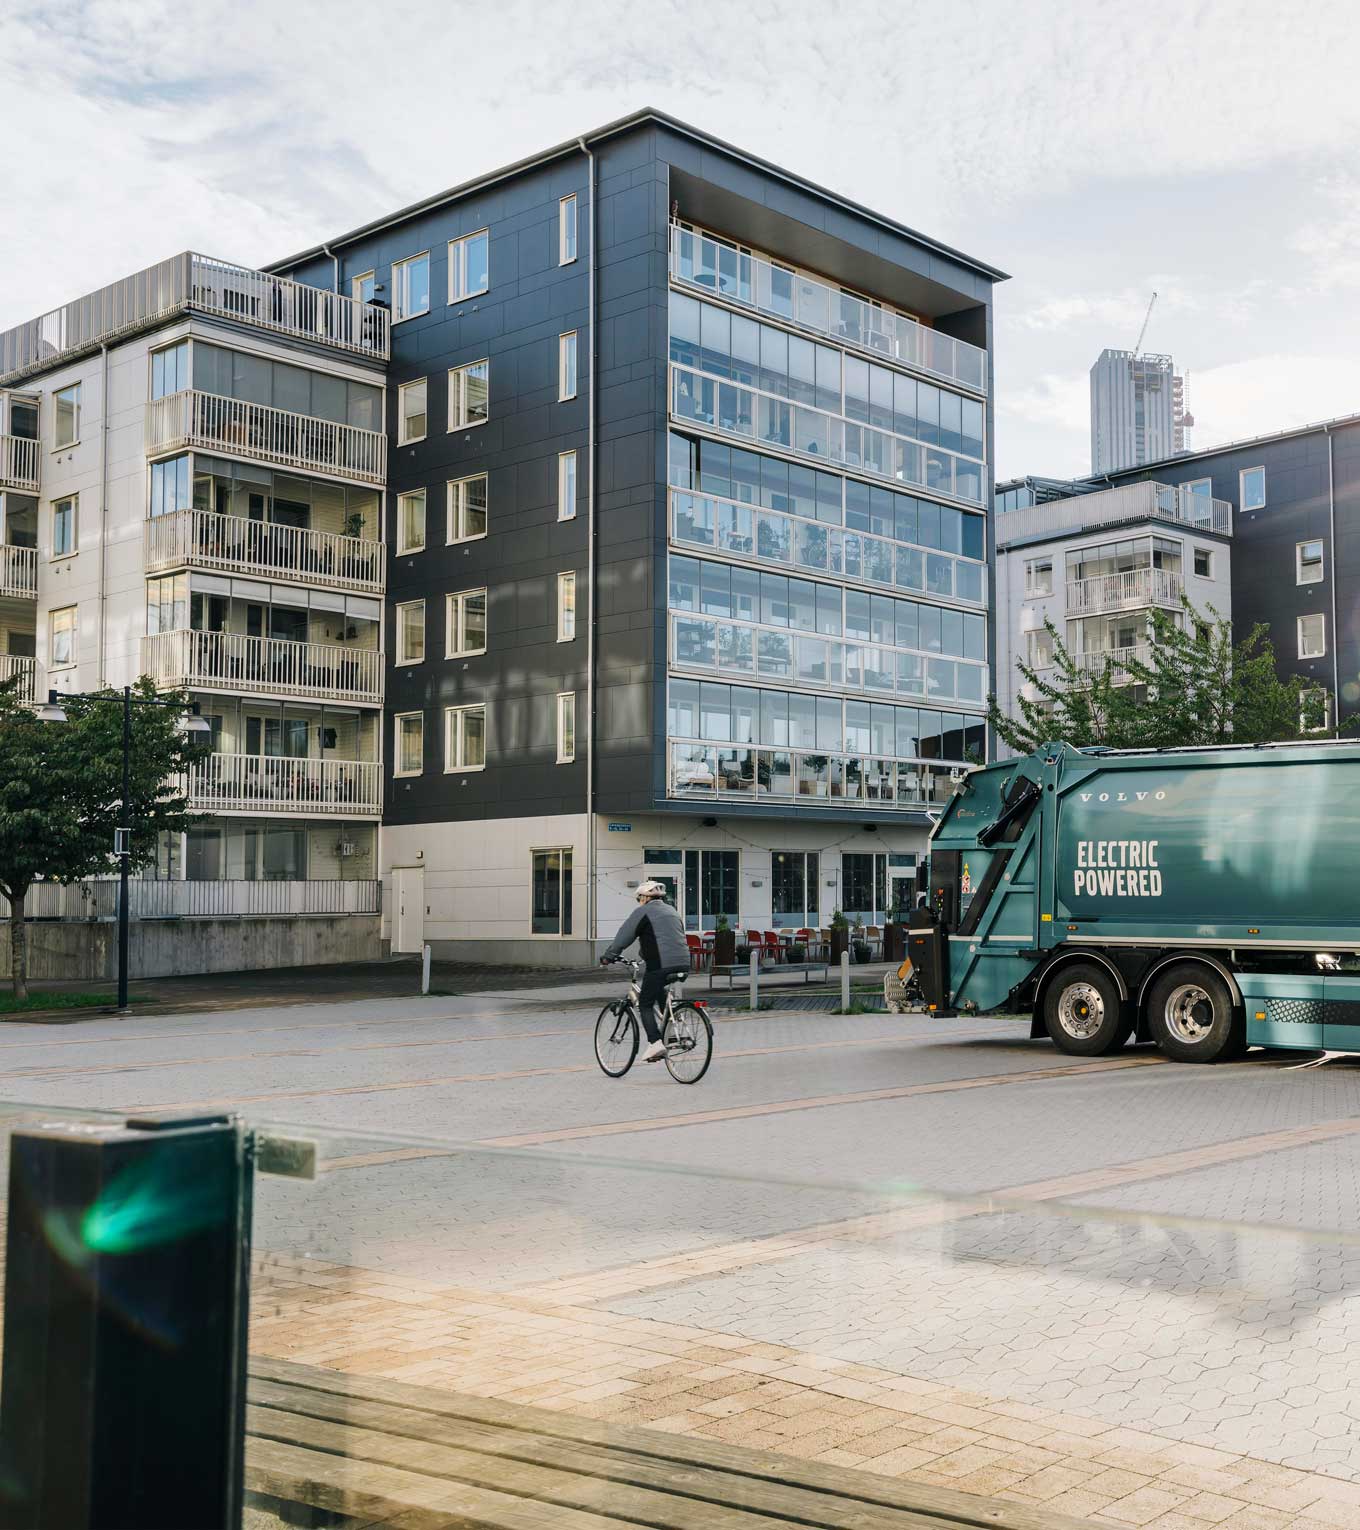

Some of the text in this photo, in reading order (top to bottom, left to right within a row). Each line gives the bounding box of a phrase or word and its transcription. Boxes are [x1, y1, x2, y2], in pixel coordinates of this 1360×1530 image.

[1080, 791, 1166, 802] VOLVO
[1077, 840, 1159, 868] ELECTRIC
[1073, 869, 1163, 897] POWERED
